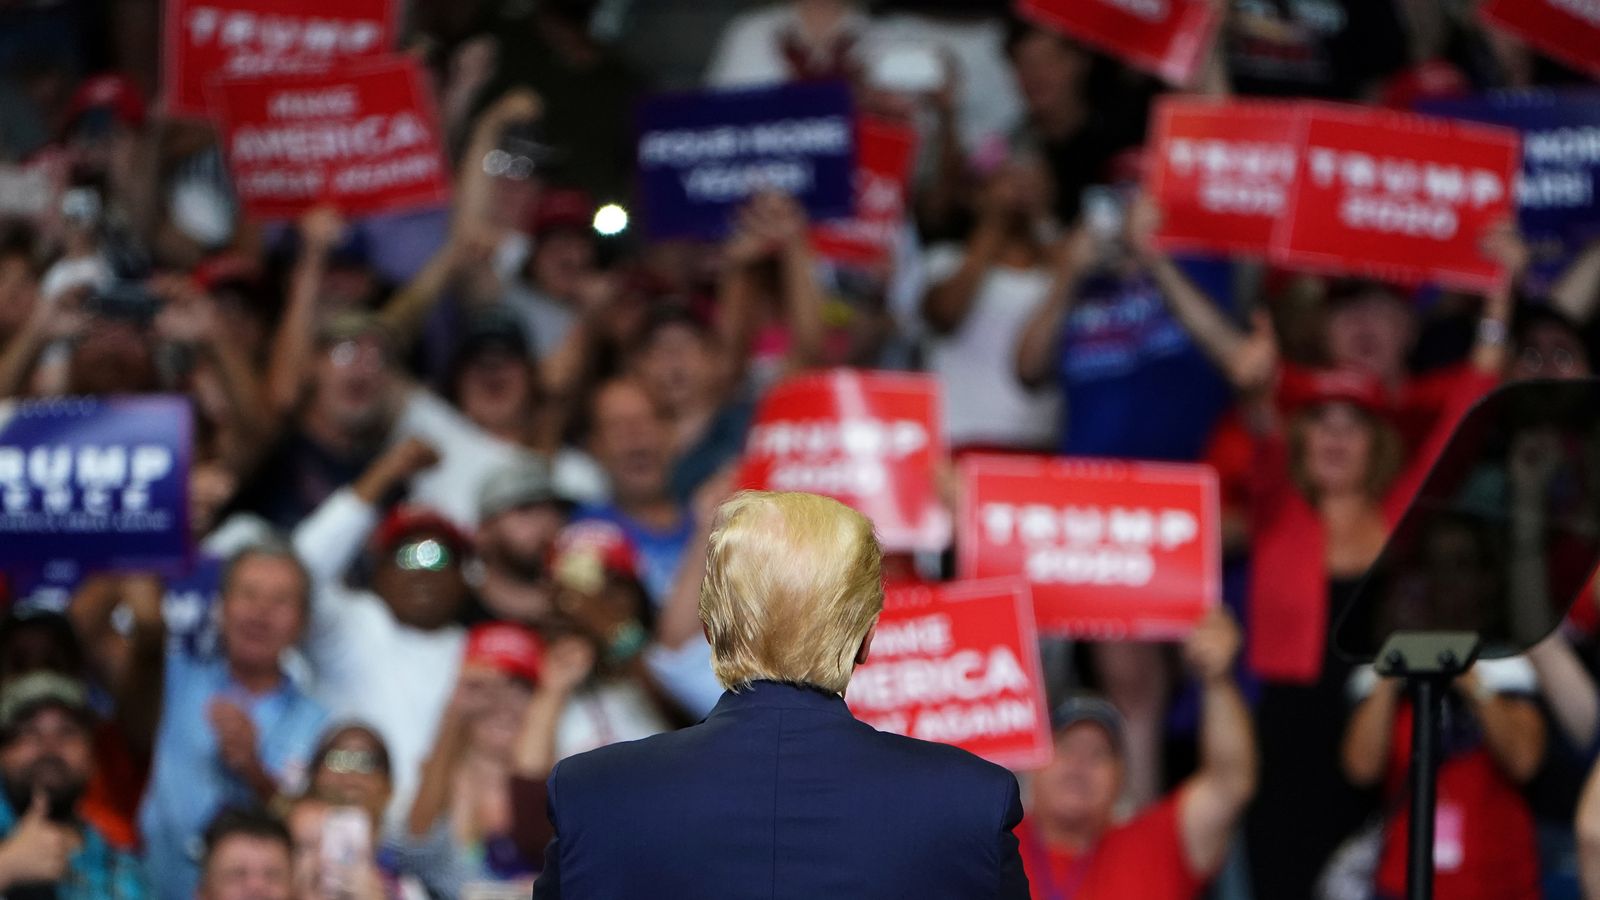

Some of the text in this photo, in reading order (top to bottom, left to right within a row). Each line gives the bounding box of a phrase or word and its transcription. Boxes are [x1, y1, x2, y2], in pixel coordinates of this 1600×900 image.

[189, 7, 380, 54] TRUMP
[233, 113, 429, 160] AMERICA
[1309, 146, 1501, 208] TRUMP
[0, 447, 172, 490] RUMP
[4, 486, 149, 514] ENCE
[983, 502, 1198, 550] TRUMP
